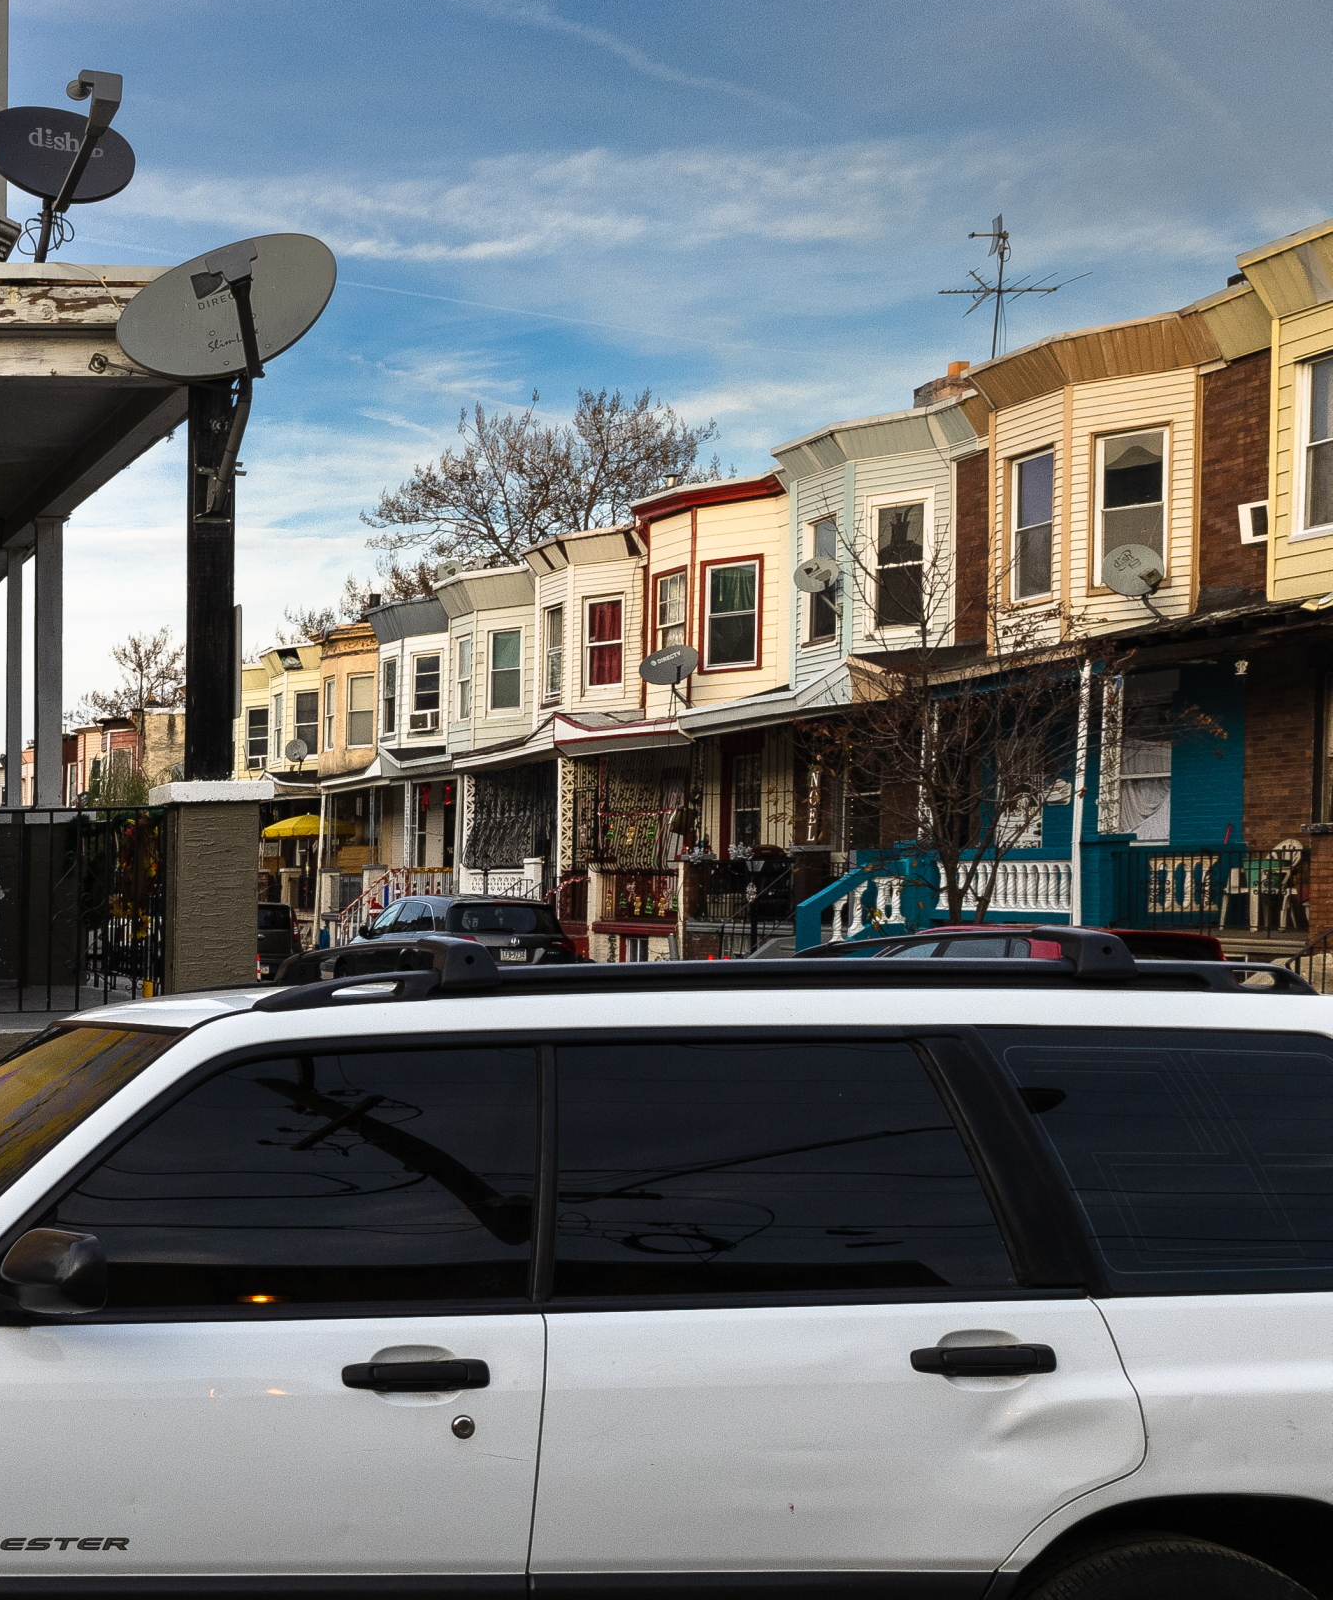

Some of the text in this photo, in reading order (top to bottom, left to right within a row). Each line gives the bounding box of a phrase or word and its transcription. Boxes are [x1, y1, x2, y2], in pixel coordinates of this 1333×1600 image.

[28, 127, 81, 153] dish
[656, 650, 681, 665] DIRECTV
[807, 770, 820, 842] NOEL
